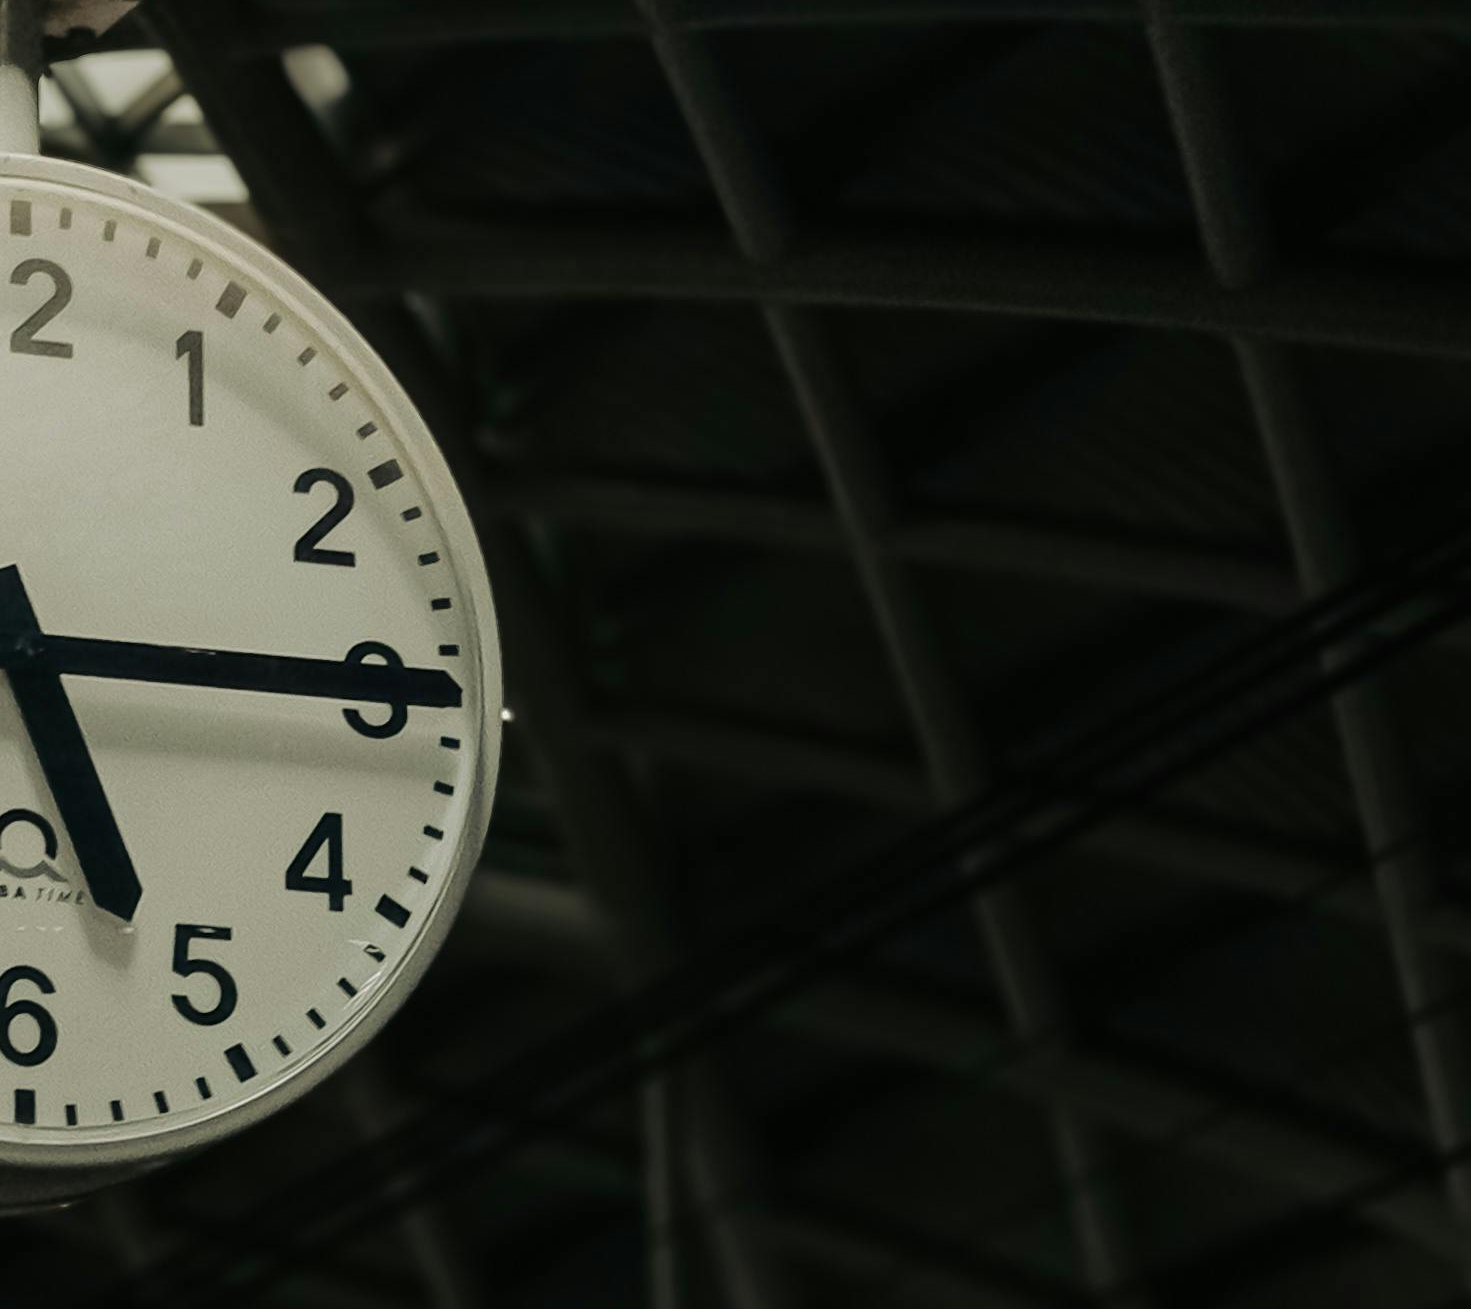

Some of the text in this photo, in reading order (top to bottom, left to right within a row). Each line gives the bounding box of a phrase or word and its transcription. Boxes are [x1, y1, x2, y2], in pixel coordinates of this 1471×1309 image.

[175, 329, 205, 427] 1
[293, 467, 356, 568] 2
[341, 640, 408, 740] 3
[285, 811, 353, 913] 4
[171, 923, 238, 1027] 5
